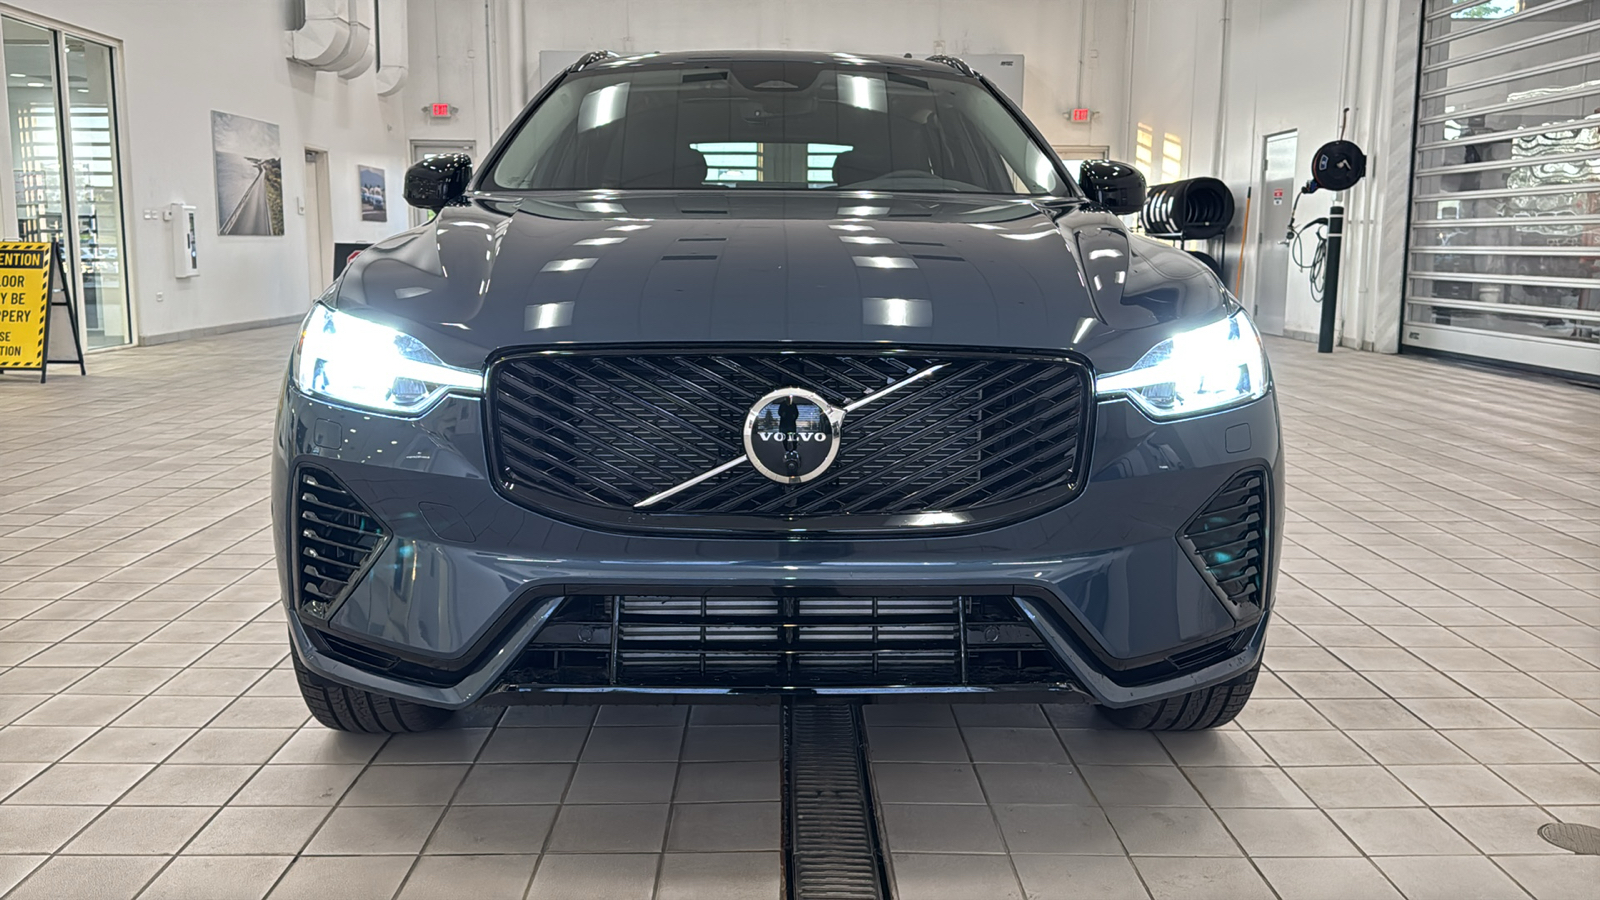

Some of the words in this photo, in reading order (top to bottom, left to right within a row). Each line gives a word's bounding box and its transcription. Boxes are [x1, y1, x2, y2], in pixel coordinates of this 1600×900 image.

[0, 275, 25, 287] OOR
[11, 293, 26, 304] BE
[0, 310, 31, 322] PERY
[757, 432, 827, 442] VOLVO
